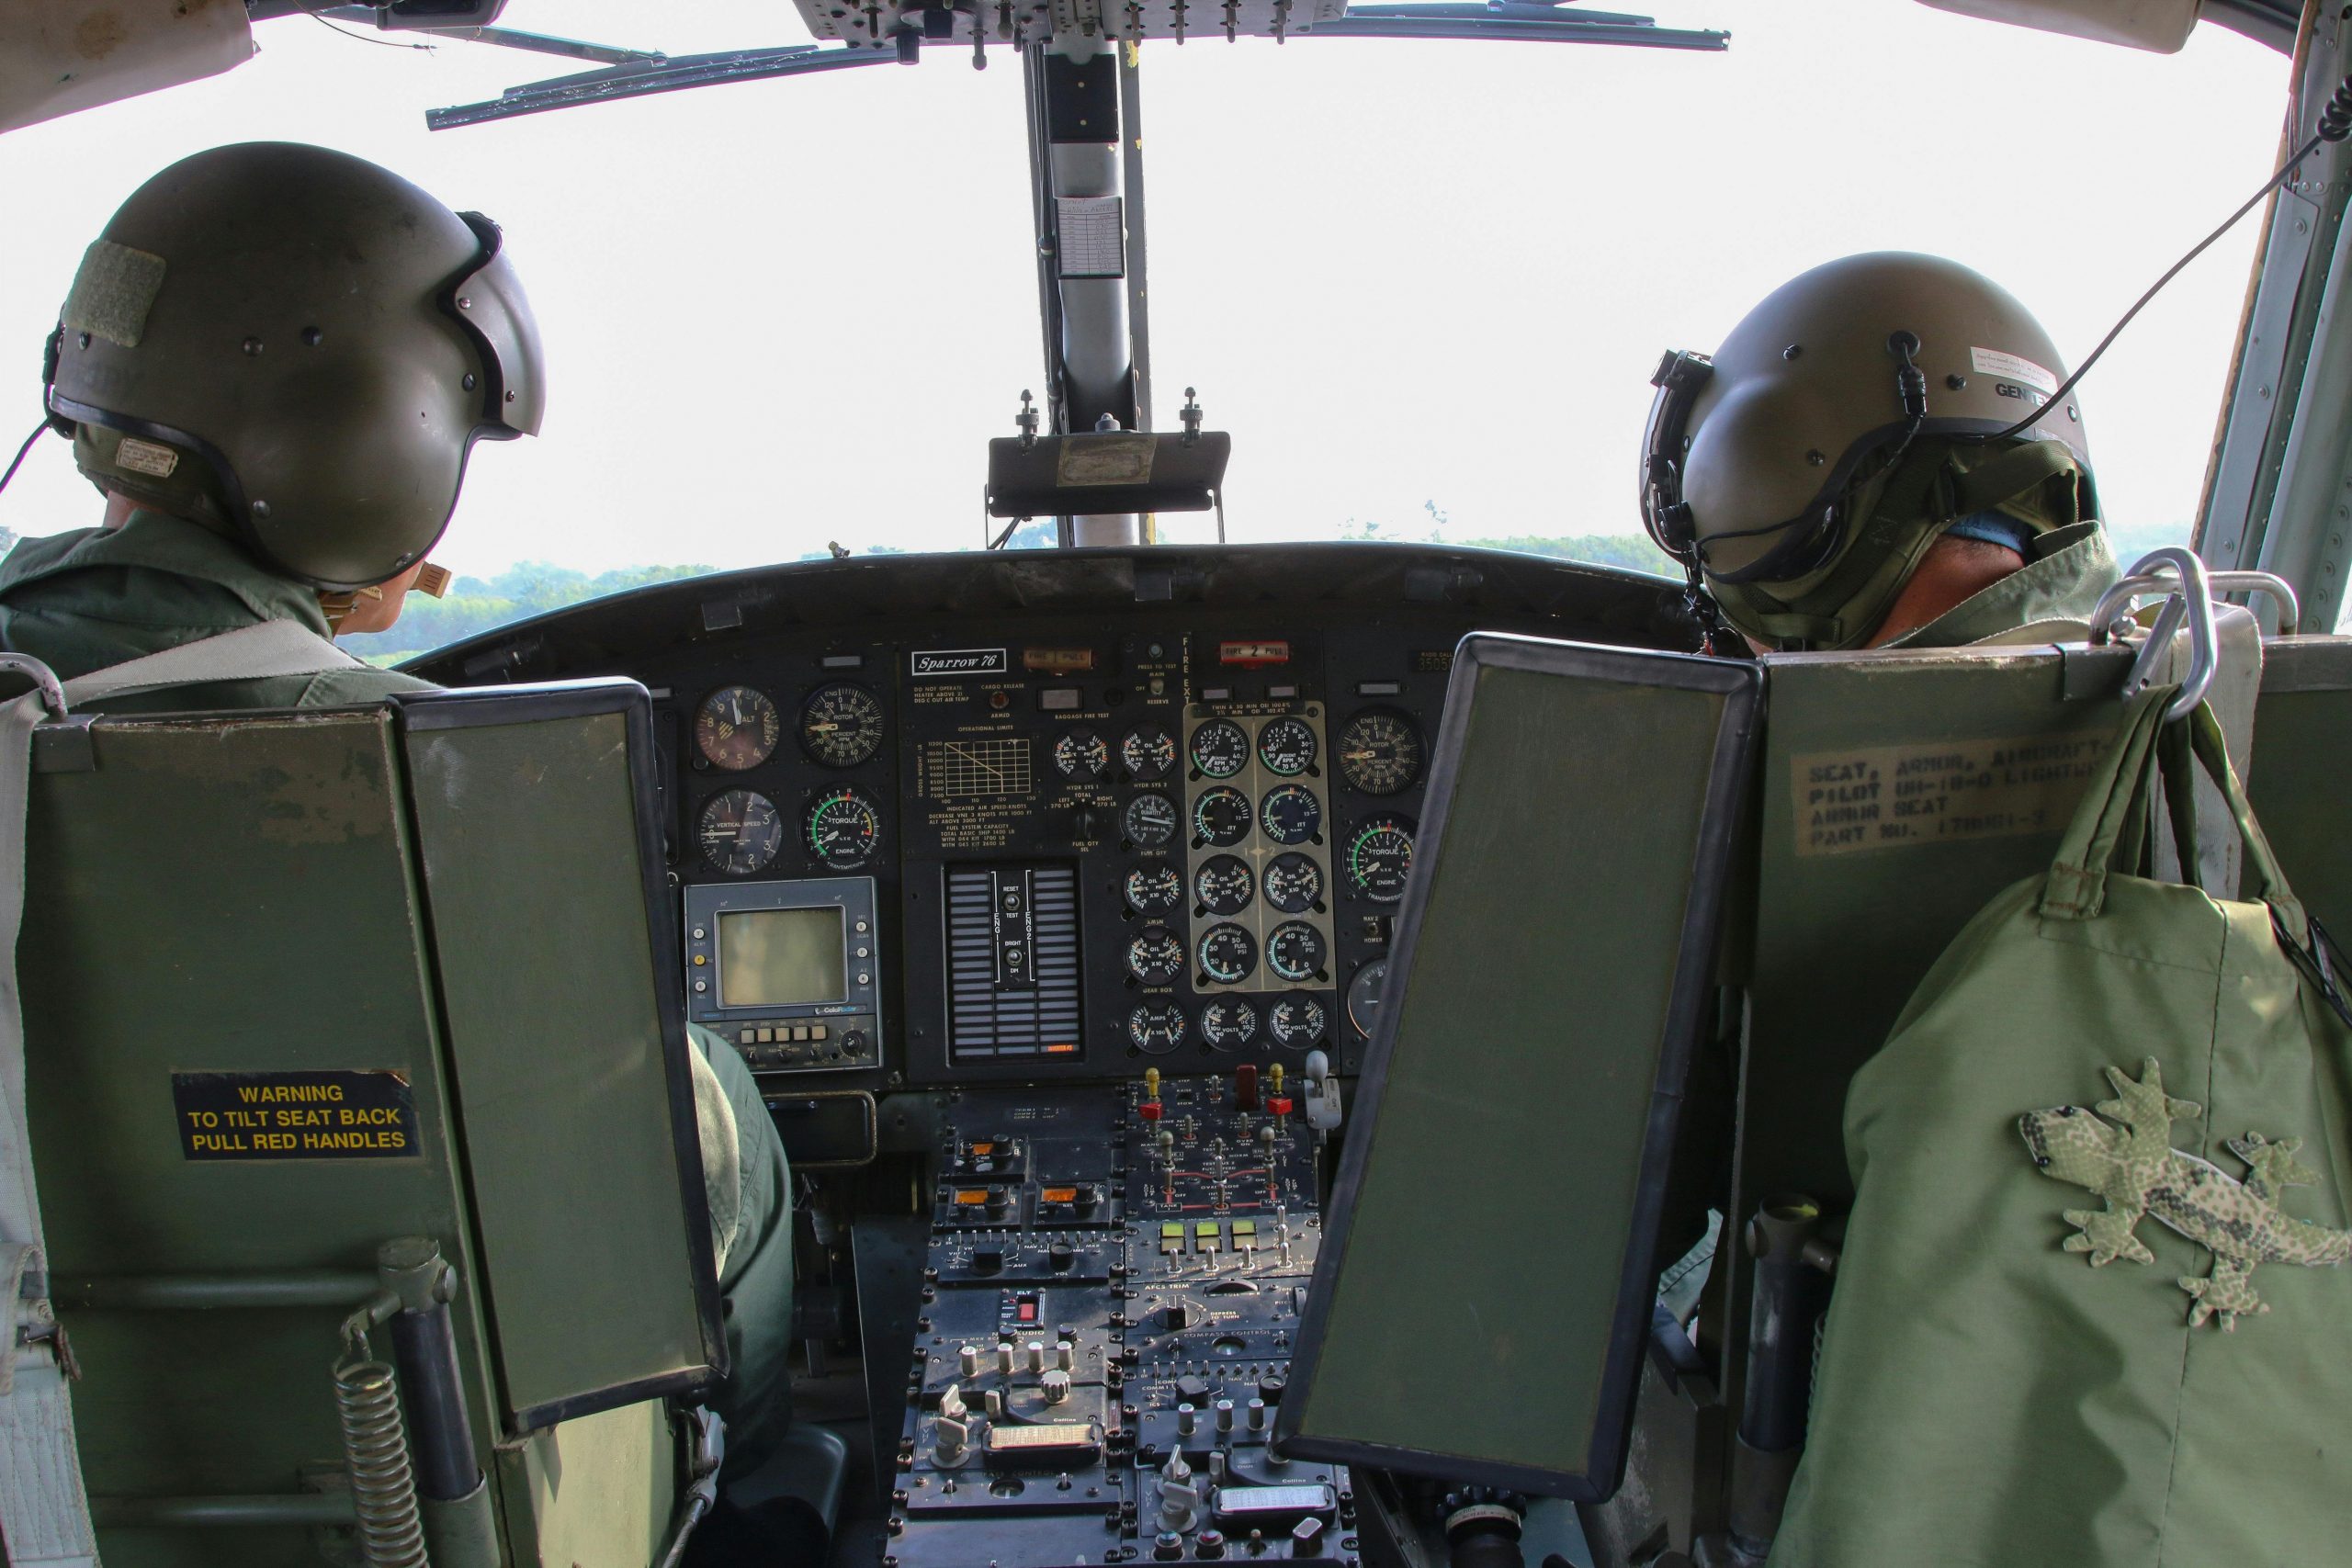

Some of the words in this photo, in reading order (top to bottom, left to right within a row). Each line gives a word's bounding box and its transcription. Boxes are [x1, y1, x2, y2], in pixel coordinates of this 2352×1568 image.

[1251, 645, 1258, 658] 2
[919, 657, 978, 671] Sparrow
[981, 655, 998, 667] 76
[1809, 783, 1881, 804] PILOT
[1895, 796, 1949, 816] SEAT
[1812, 826, 1865, 846] PART
[238, 1085, 344, 1103] WARNING
[187, 1111, 219, 1129] TO
[223, 1111, 270, 1127] TILT
[277, 1110, 332, 1126] SEAT
[339, 1108, 401, 1125] BACK
[191, 1134, 247, 1151] PULL
[253, 1134, 297, 1150] RED
[303, 1132, 406, 1149] HANDLES
